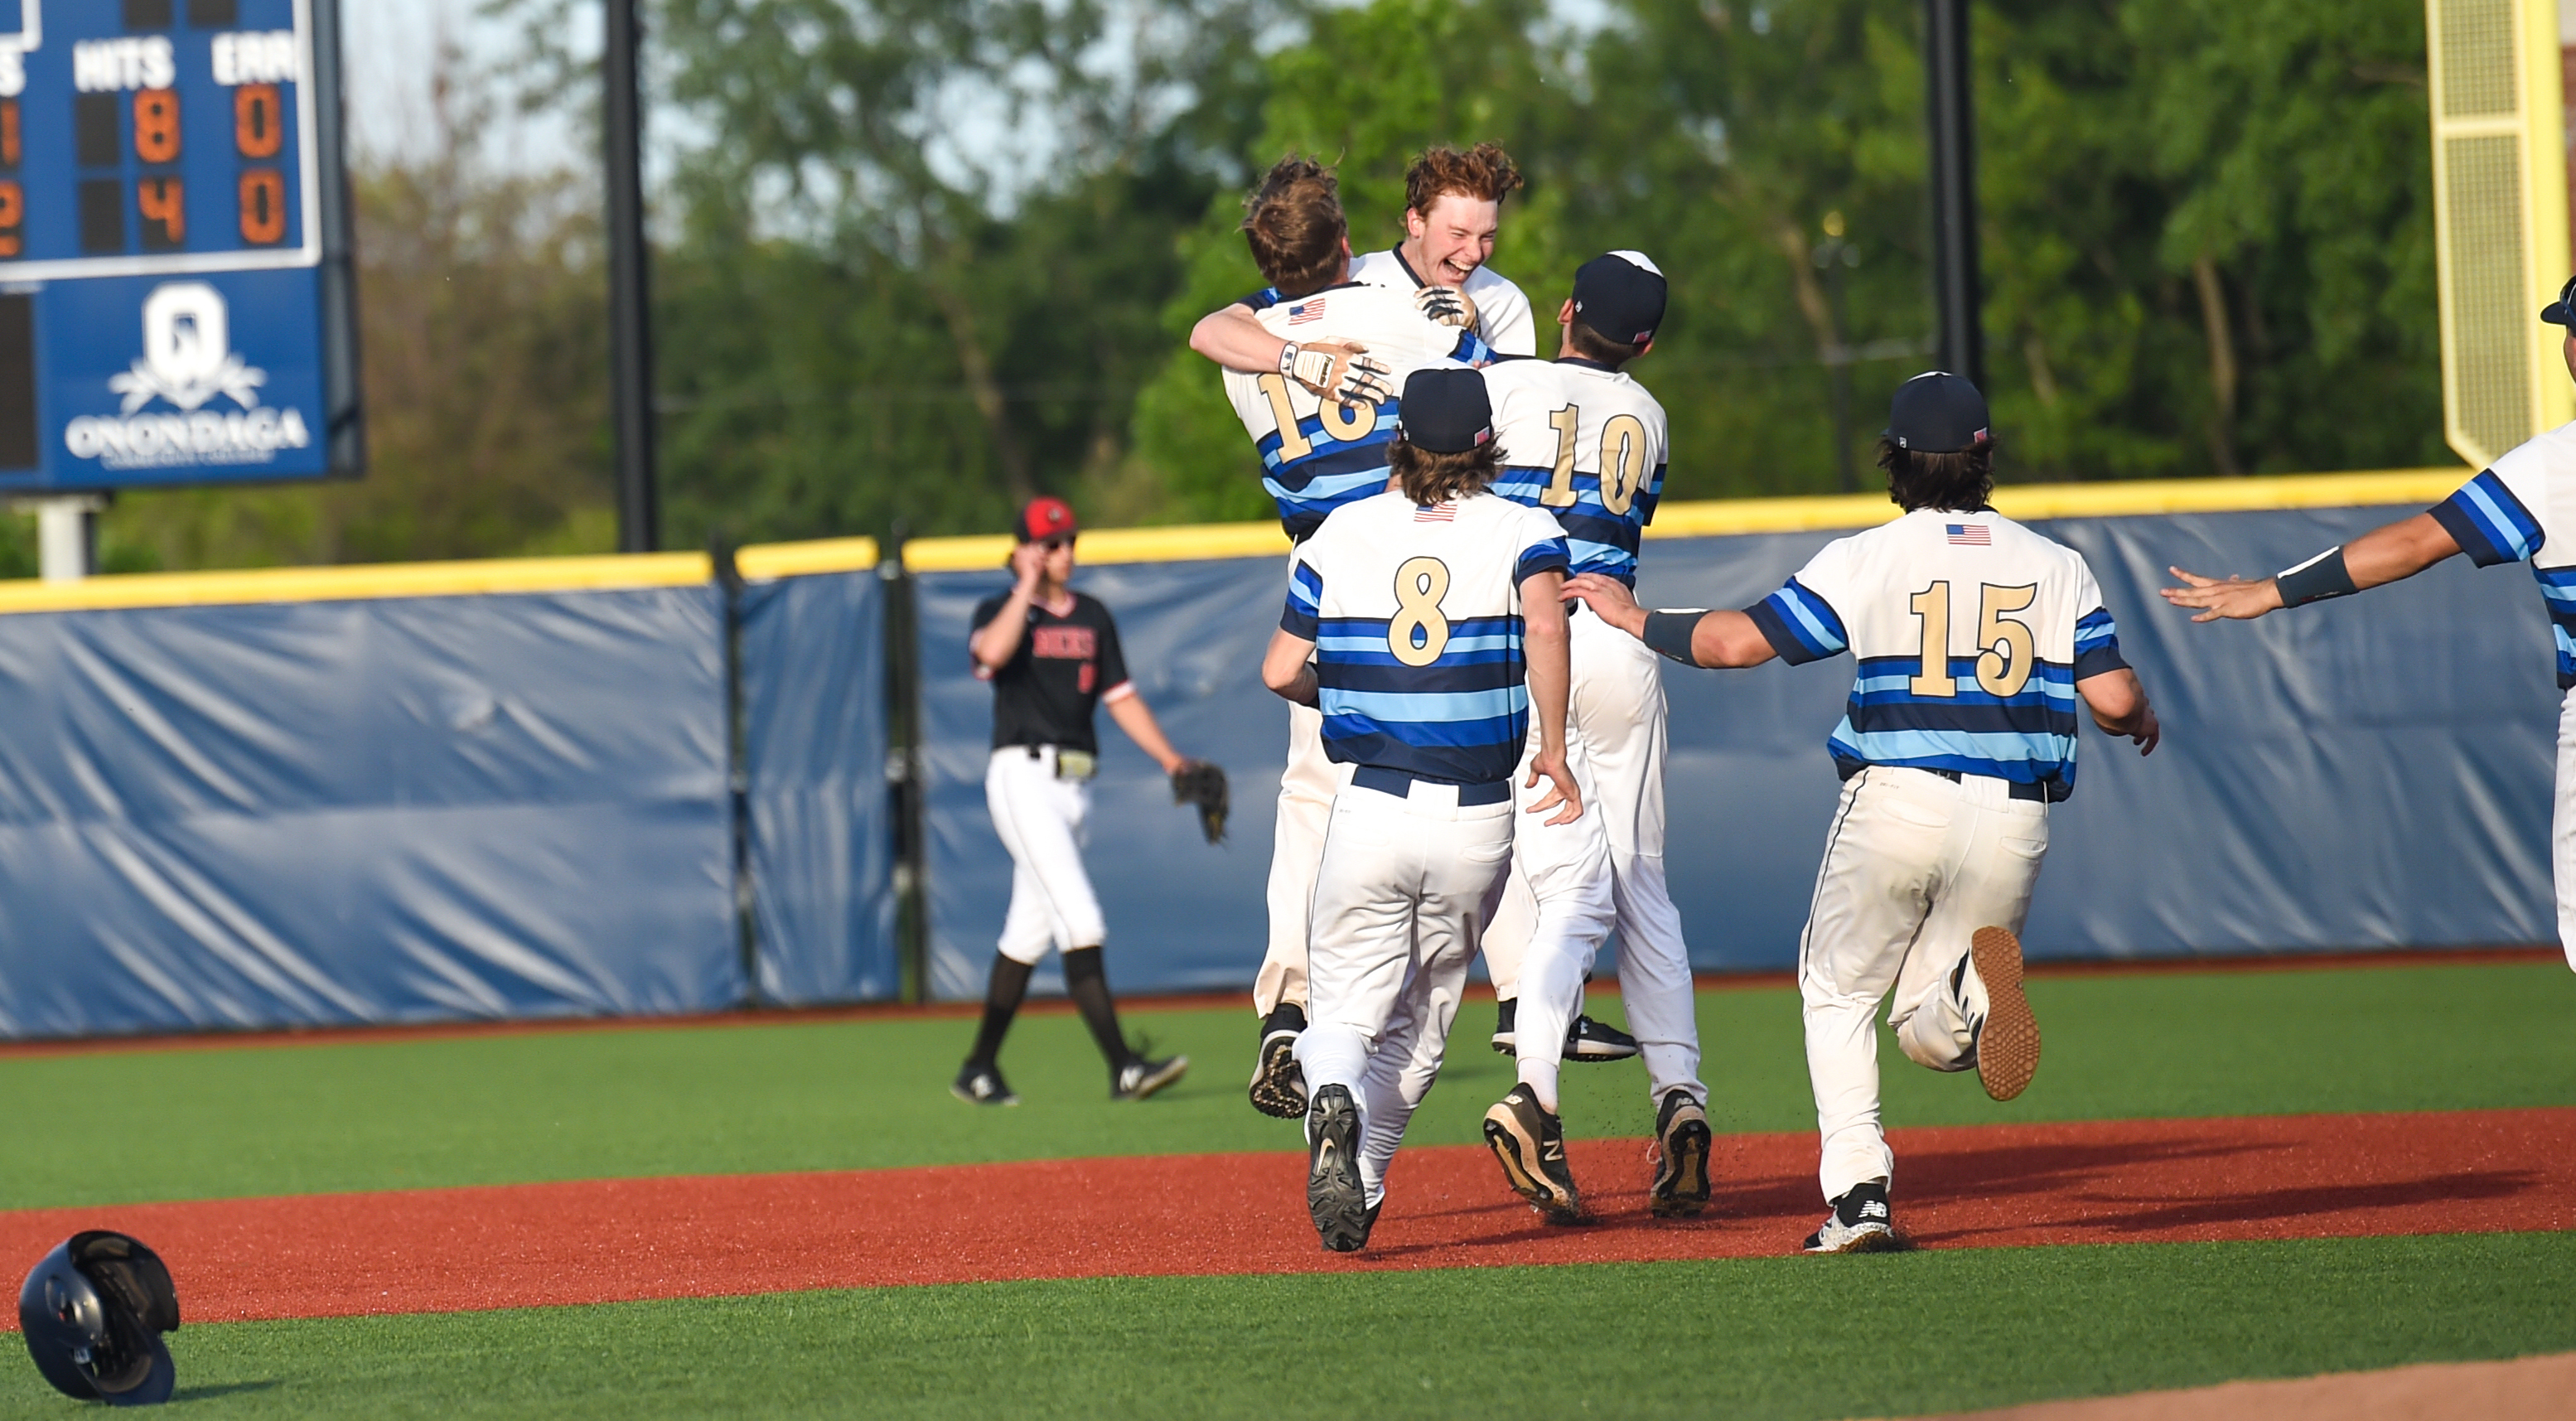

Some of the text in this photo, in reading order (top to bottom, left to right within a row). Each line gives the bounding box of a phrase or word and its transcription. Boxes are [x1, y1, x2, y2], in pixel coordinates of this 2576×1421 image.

[75, 36, 175, 91] HITS
[134, 88, 180, 162] 8
[236, 83, 281, 157] 0
[139, 176, 184, 244] 4
[239, 170, 285, 244] 0
[65, 407, 310, 458] ONONDAGA
[1539, 403, 1646, 516] 10
[1388, 556, 1450, 666] 8
[1910, 580, 2037, 698] 15
[1543, 1140, 1563, 1161] N
